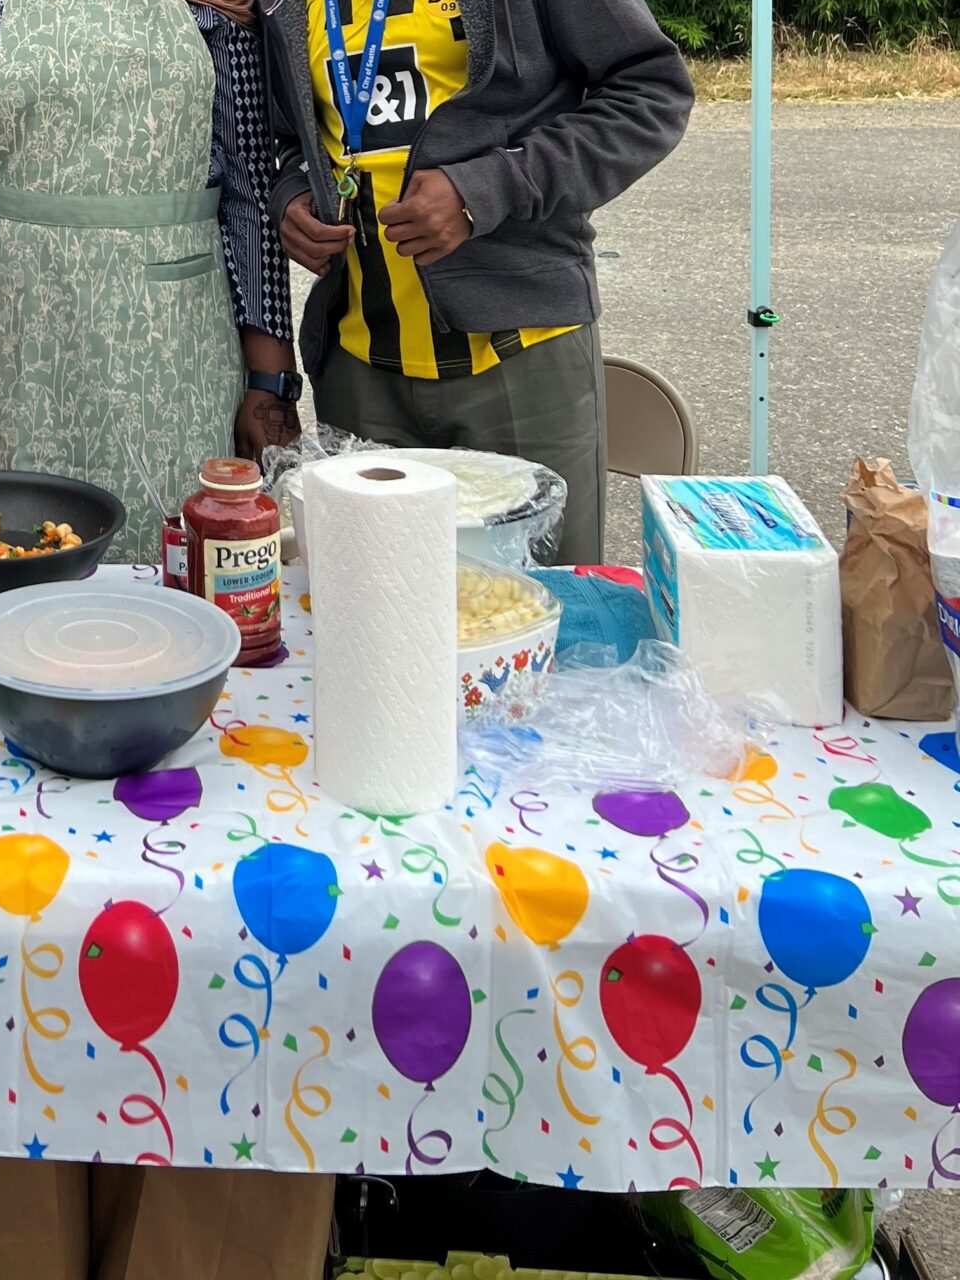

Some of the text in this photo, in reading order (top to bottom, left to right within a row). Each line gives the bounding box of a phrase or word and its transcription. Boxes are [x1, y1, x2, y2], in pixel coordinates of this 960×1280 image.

[329, 5, 338, 29] Seattle
[441, 2, 457, 12] 09
[337, 61, 346, 74] City
[362, 44, 377, 89] City of Seattle
[341, 81, 352, 105] Seattle
[215, 540, 277, 571] Prego
[222, 576, 249, 587] LOWER
[251, 567, 274, 584] SODIUM
[229, 585, 271, 604] Traditional
